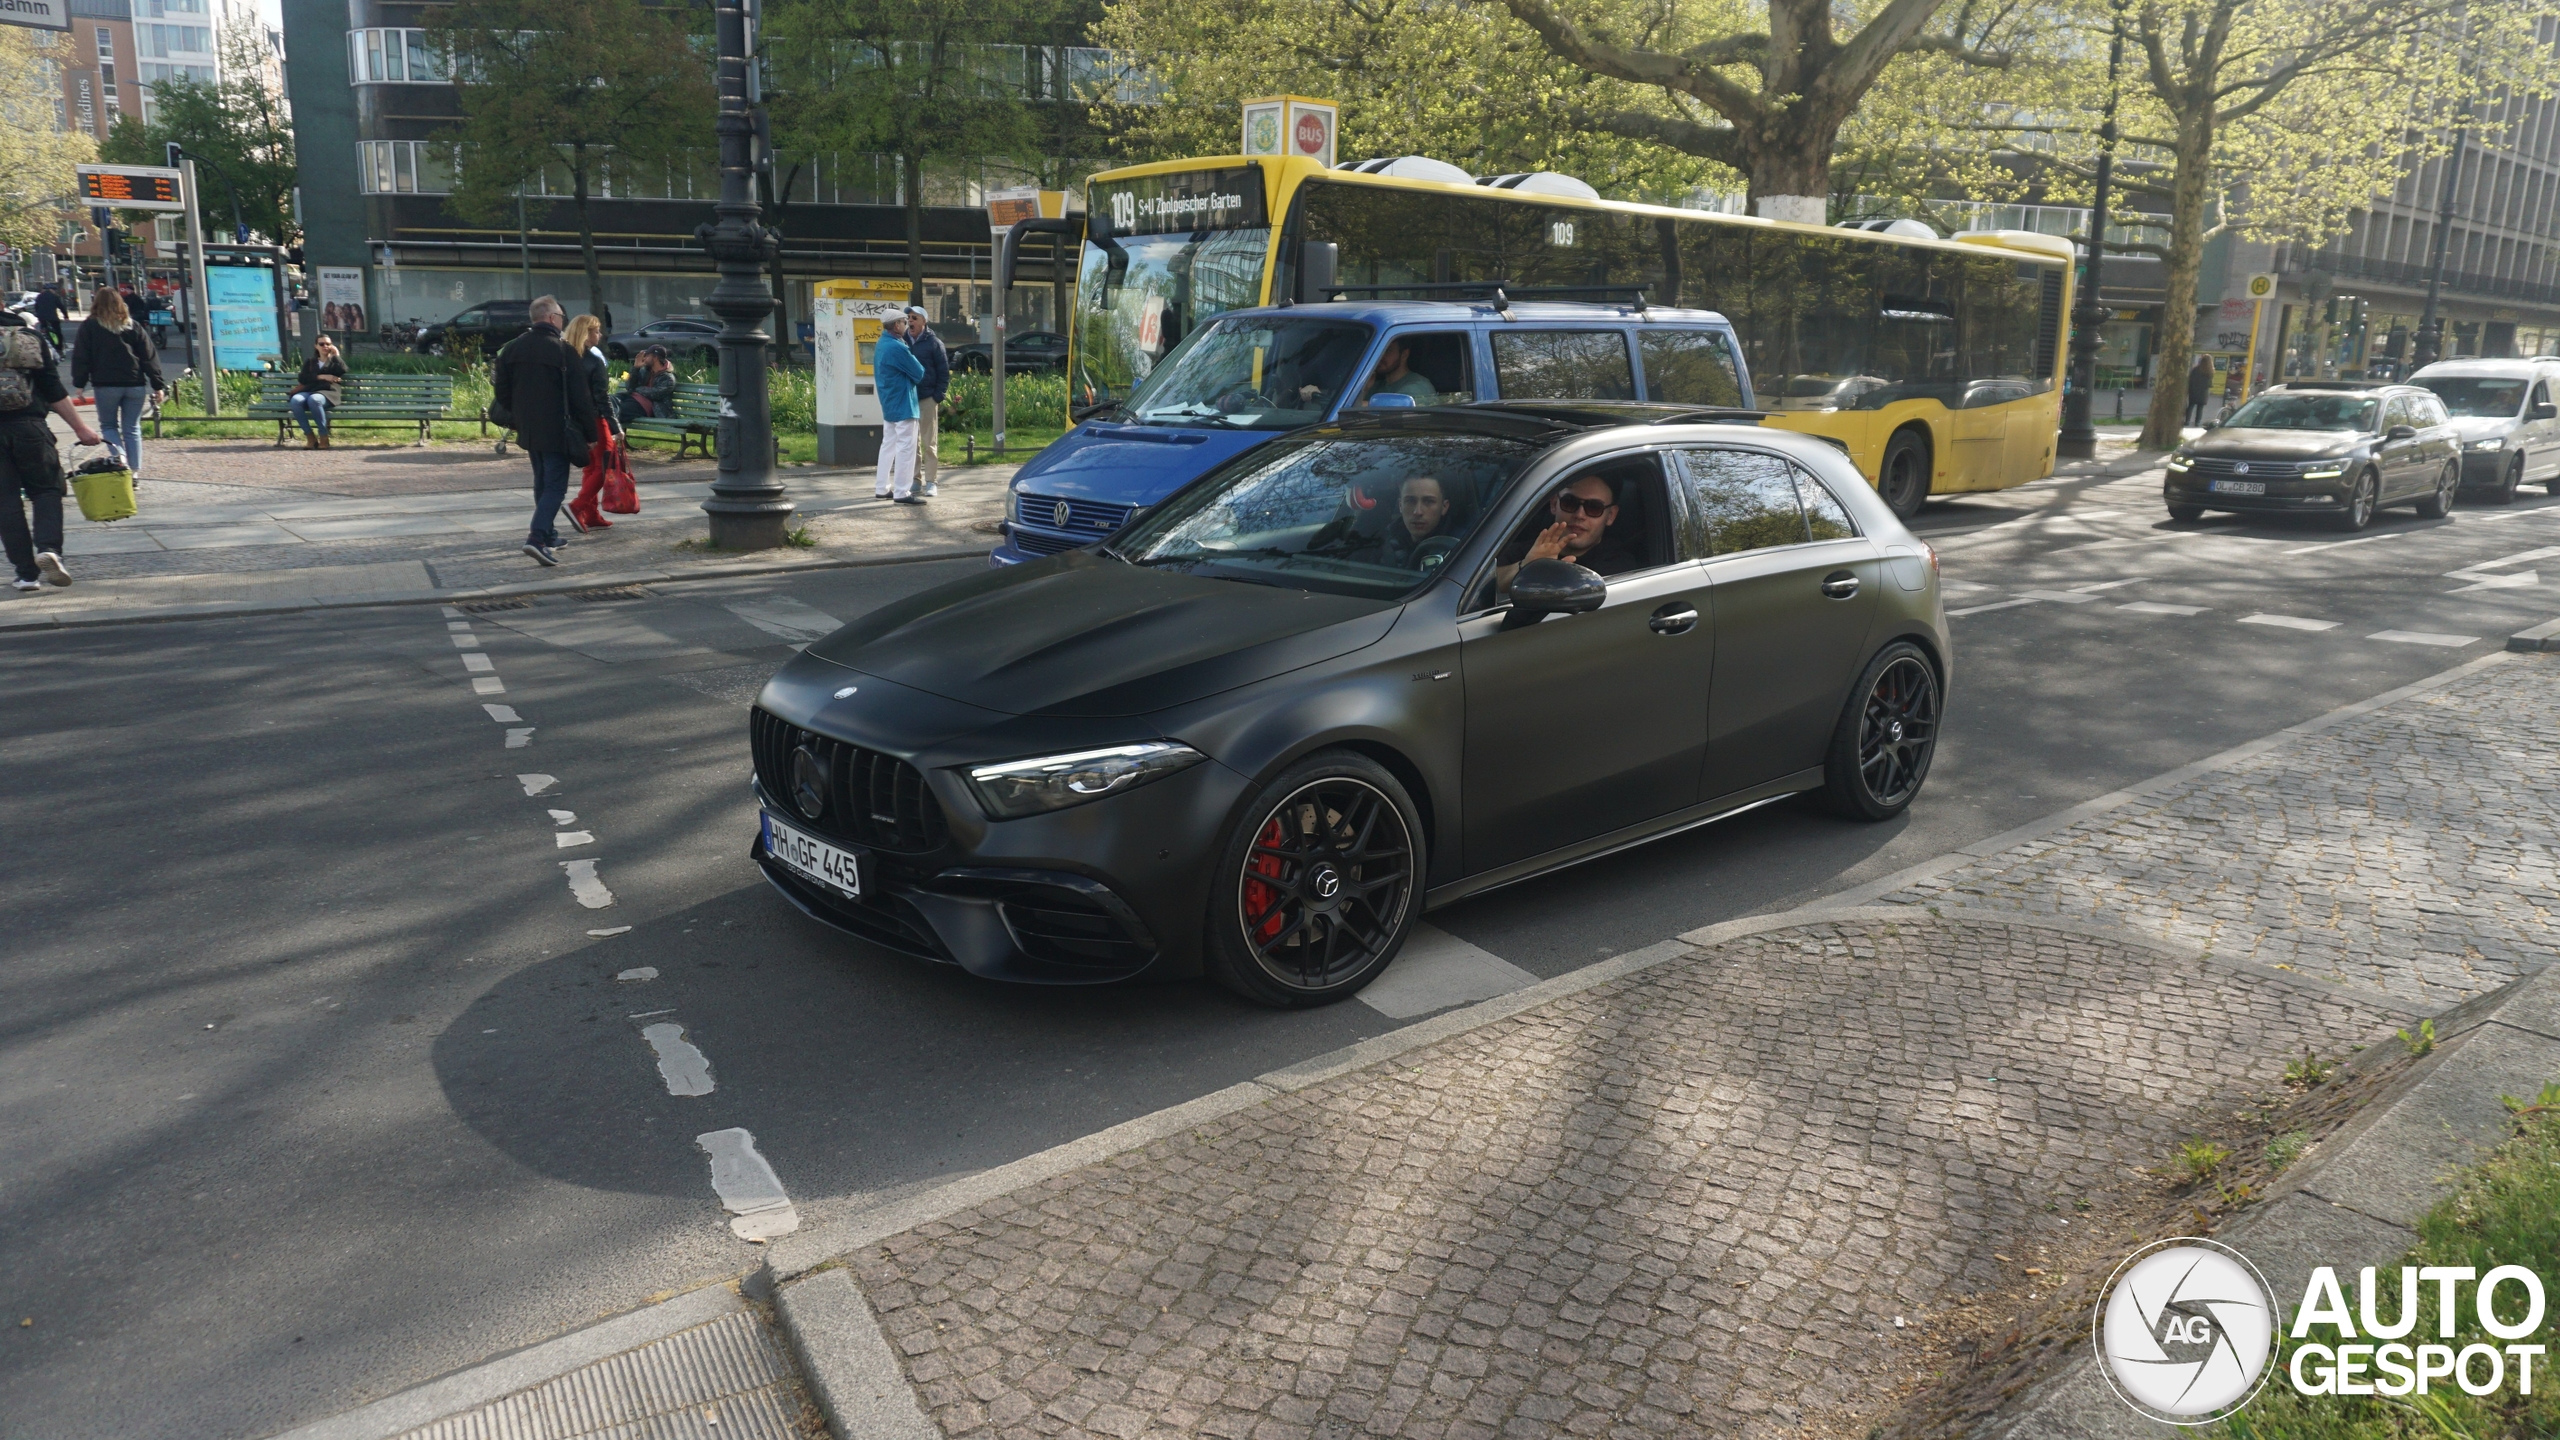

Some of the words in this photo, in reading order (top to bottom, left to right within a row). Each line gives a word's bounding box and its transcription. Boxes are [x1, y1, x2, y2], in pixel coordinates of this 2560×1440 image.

[1298, 125, 1323, 143] BUS
[1111, 191, 1135, 228] 109
[1138, 198, 1154, 216] S+U
[1155, 193, 1208, 214] Zoologischer
[1211, 192, 1242, 210] Garten
[1552, 221, 1574, 245] 109
[223, 316, 263, 325] Bewerben
[233, 327, 250, 335] sich
[770, 821, 790, 858] HH
[798, 836, 818, 870] GF
[823, 848, 856, 888] 445
